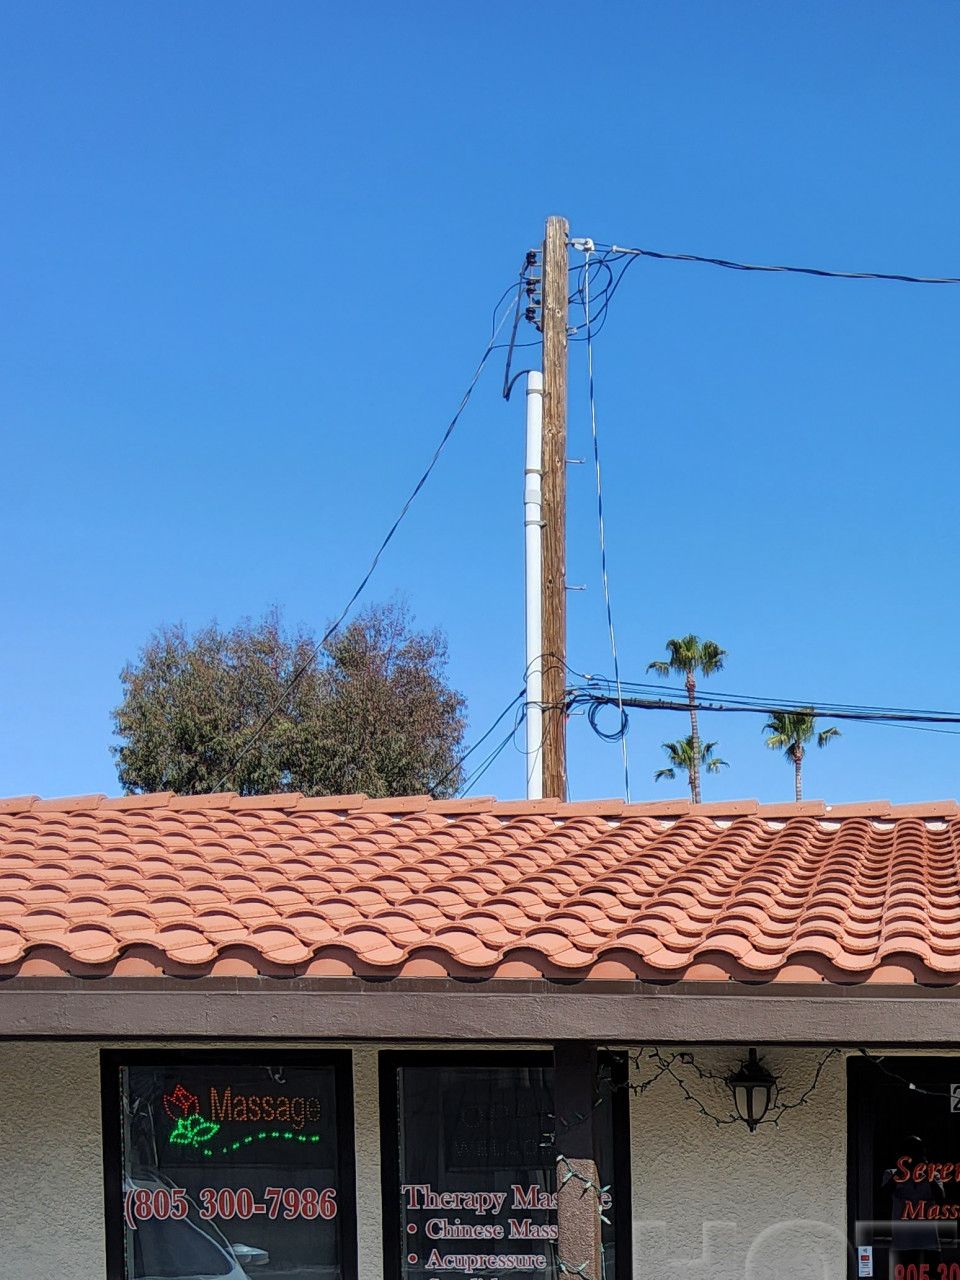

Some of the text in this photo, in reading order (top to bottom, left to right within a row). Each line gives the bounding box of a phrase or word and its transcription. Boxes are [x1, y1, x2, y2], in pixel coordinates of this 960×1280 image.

[209, 1087, 321, 1130] Massage
[124, 1187, 338, 1230] (805 300-7986
[401, 1184, 613, 1214] Therapy Mase
[425, 1218, 559, 1239] Chinese Mass
[425, 1249, 547, 1273] Acupressure
